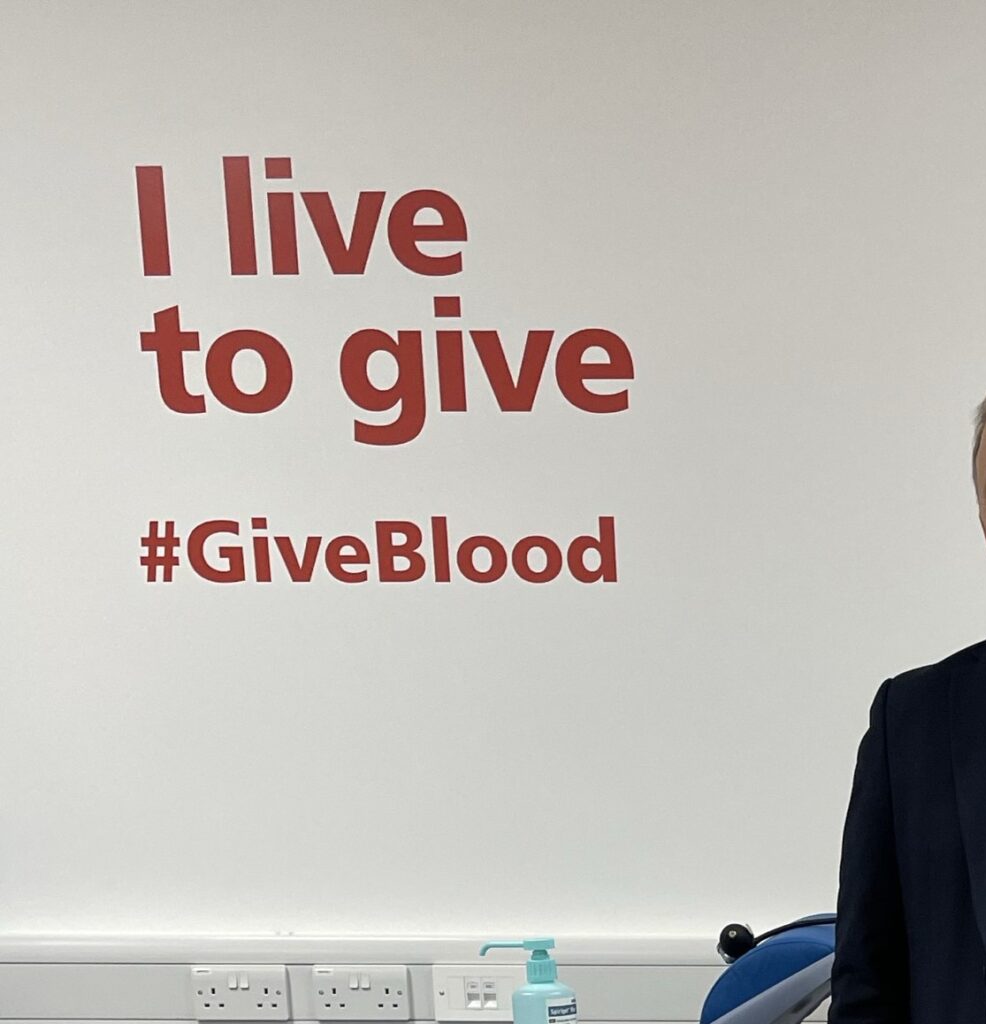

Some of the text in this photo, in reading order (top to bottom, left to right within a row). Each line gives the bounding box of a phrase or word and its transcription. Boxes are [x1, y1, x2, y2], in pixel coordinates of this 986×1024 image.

[137, 156, 468, 276] I live
[141, 296, 636, 446] to give
[140, 515, 618, 584] #GiveBlood
